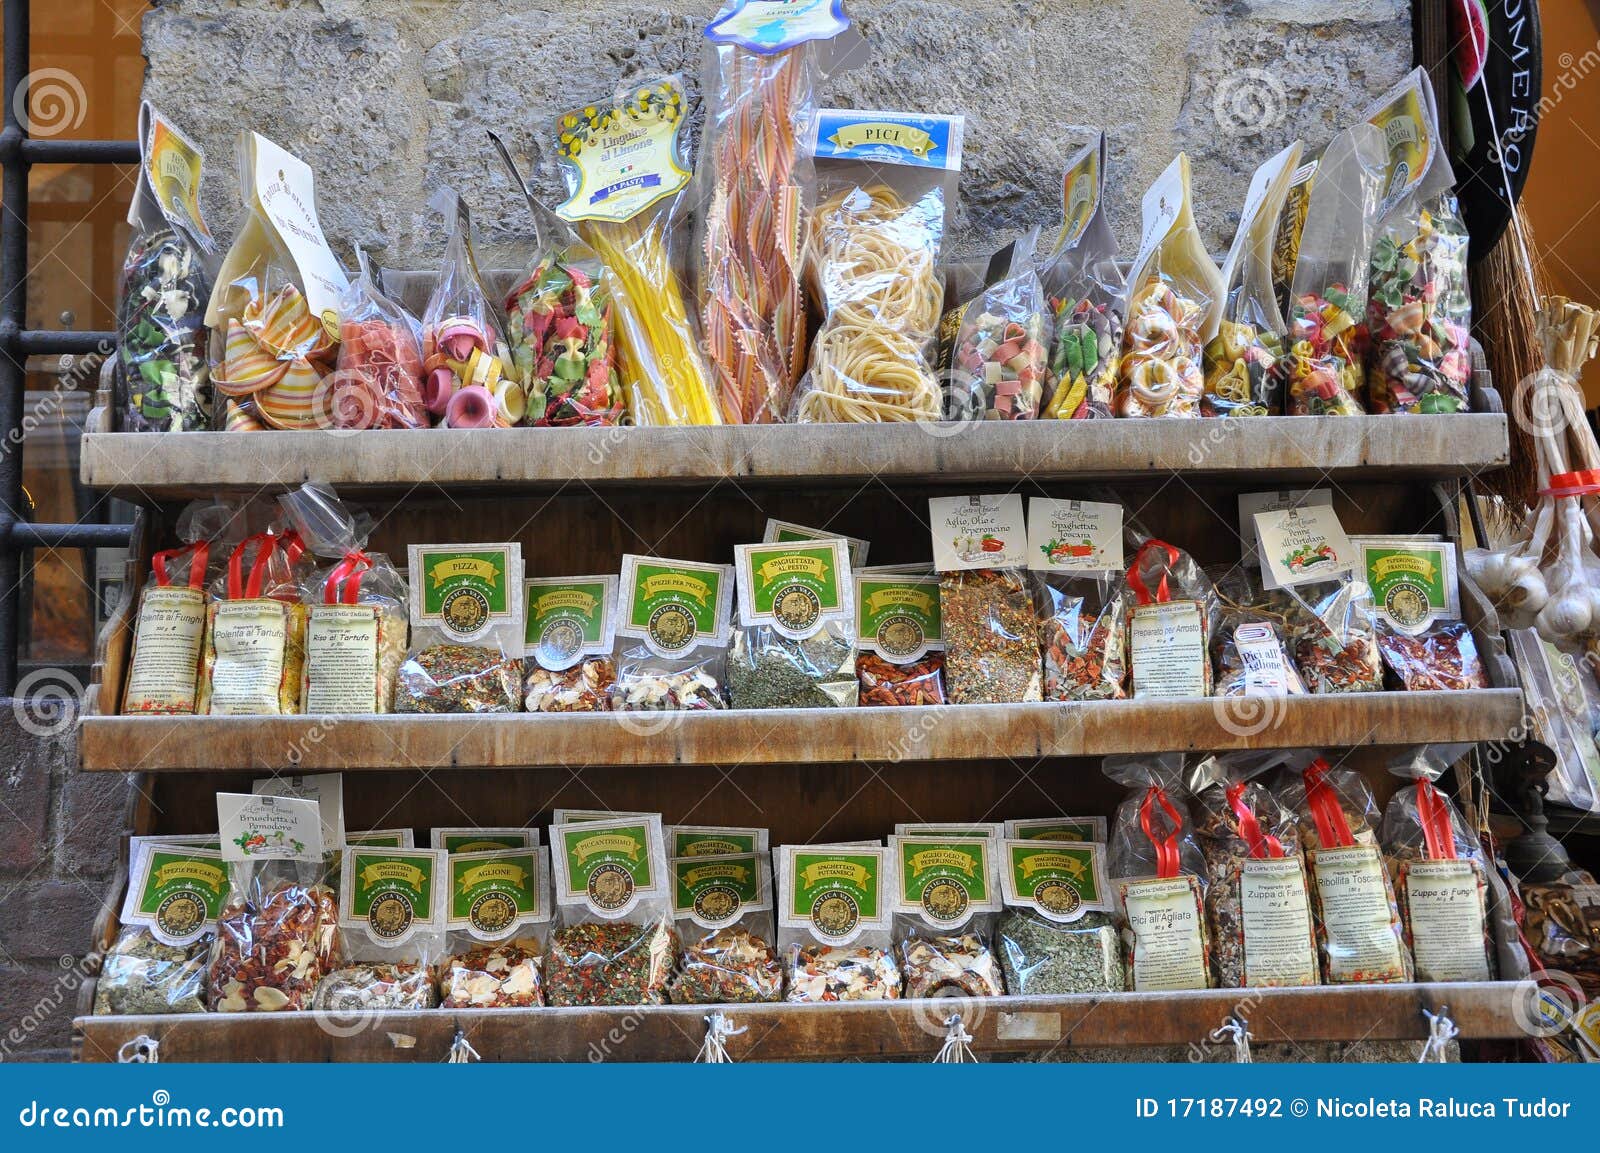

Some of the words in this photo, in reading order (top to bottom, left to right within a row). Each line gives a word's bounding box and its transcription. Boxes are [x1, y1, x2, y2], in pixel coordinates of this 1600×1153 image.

[602, 127, 648, 149] Linguine
[865, 128, 901, 142] PICI
[613, 138, 653, 158] Limone
[620, 177, 645, 190] PASTA
[971, 516, 989, 525] Olio
[1051, 520, 1098, 532] Spaghettata
[961, 525, 1011, 537] Peperoncino
[1059, 529, 1091, 539] Toscana
[452, 562, 479, 571] PIZZA
[770, 557, 816, 568] SPAGHETTATA
[650, 579, 671, 587] SPEZIE
[685, 581, 704, 591] PESCE
[175, 612, 203, 625] Funghi
[215, 629, 244, 639] Polenta
[256, 628, 284, 638] Tartufo
[1133, 628, 1164, 638] Preparato
[1164, 627, 1175, 636] per
[1176, 624, 1200, 633] Arrosto
[340, 633, 370, 641] Tartufo
[1242, 649, 1262, 665] Pici
[1248, 659, 1281, 673] Aglione
[240, 814, 288, 823] Bruschetta
[290, 816, 298, 825] al
[249, 823, 292, 831] Pomodoro
[580, 839, 632, 850] PICCANTISSIMO
[943, 852, 960, 860] OLIO
[478, 868, 513, 877] AGLIONE
[1318, 876, 1350, 888] Ribollita
[1247, 890, 1276, 900] Zuppa
[1411, 888, 1438, 899] Zuppa
[1131, 914, 1147, 925] Pici
